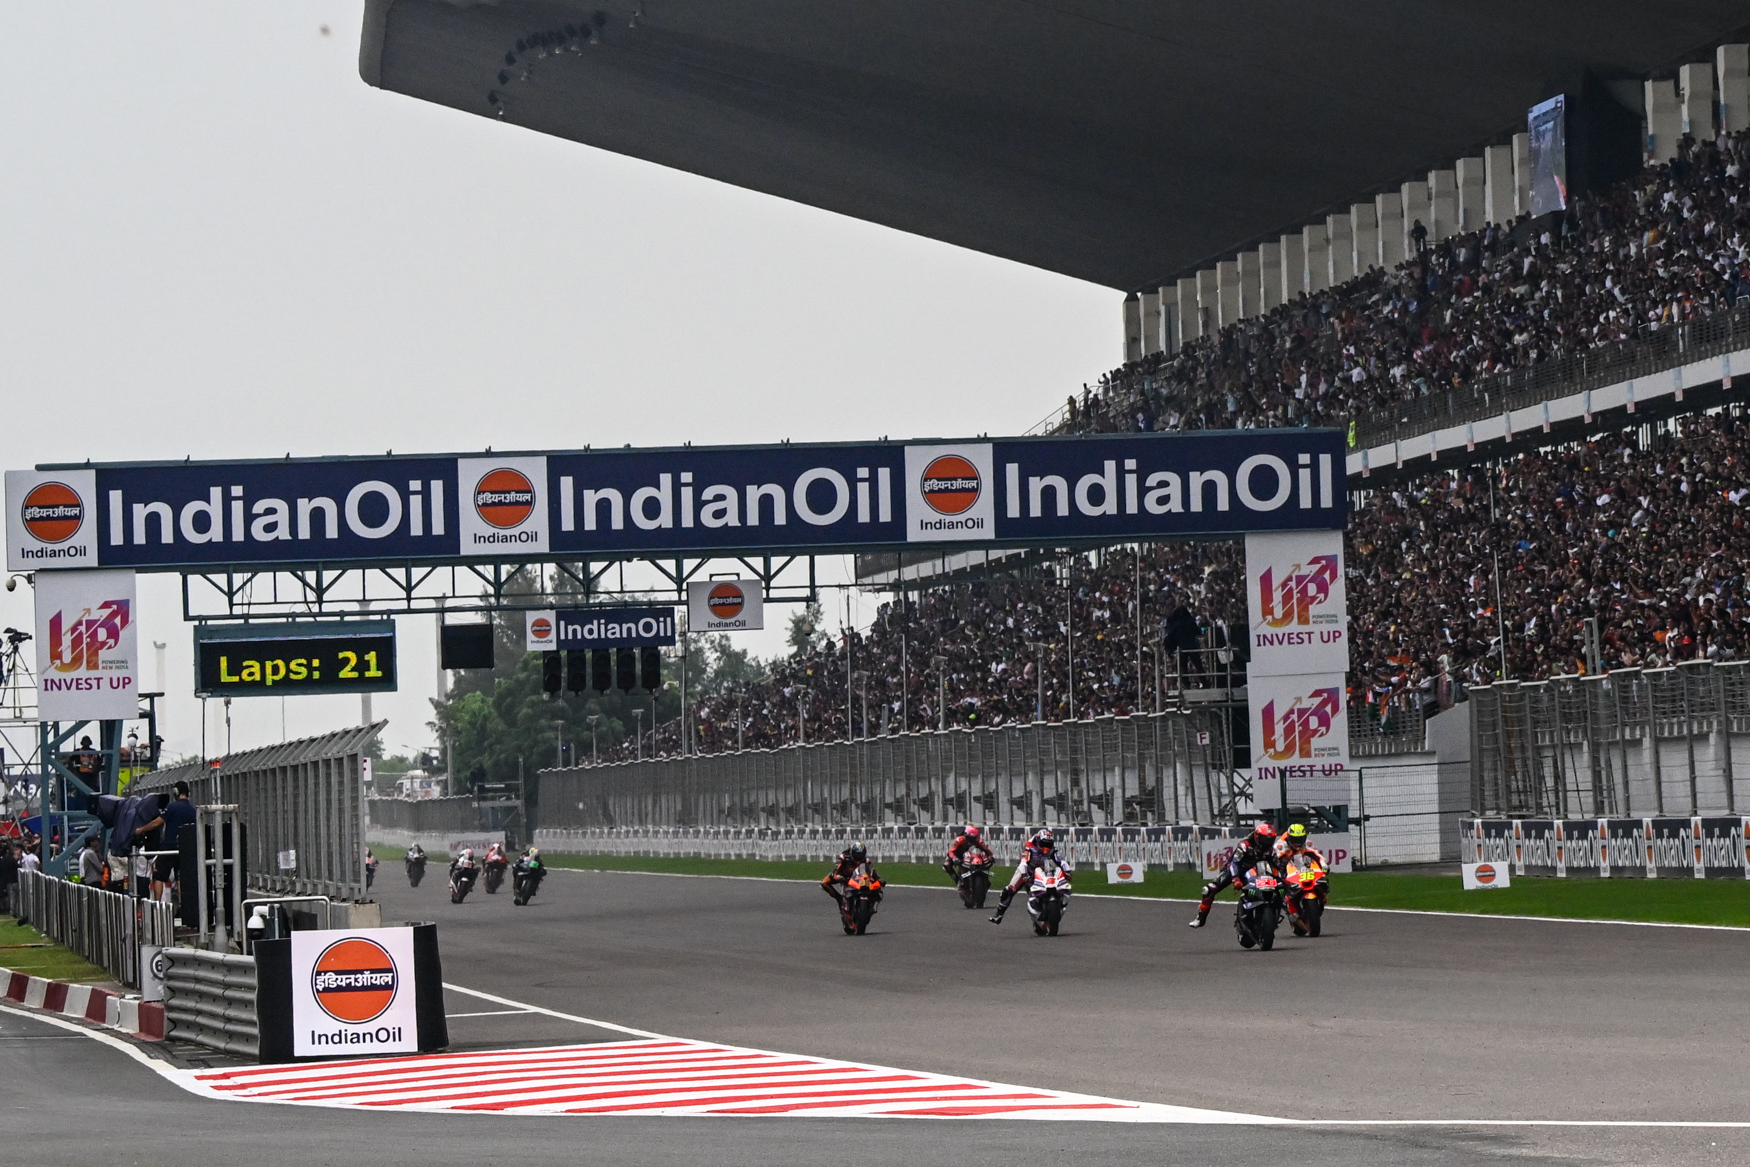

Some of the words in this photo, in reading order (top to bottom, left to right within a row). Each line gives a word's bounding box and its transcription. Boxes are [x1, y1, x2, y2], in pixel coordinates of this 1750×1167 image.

[923, 478, 978, 493] इंडियनऑयल
[1005, 452, 1333, 519] IndianOil
[477, 491, 532, 506] इंडियनऑयल
[560, 466, 892, 532] IndianOil
[25, 505, 80, 521] इंडियनऑयल
[109, 479, 444, 547] IndianOil
[920, 517, 984, 531] IndianOil
[473, 530, 539, 545] IndianOil
[21, 545, 87, 559] IndianOil
[559, 617, 672, 640] IndianOil
[707, 619, 747, 629] IndianOil
[1256, 631, 1315, 647] INVEST
[1320, 630, 1342, 644] UP
[220, 655, 320, 685] Laps:
[338, 650, 383, 679] 21
[43, 677, 103, 691] INVEST
[109, 676, 132, 689] UP
[1200, 732, 1207, 744] F
[1258, 764, 1316, 780] INVEST
[1321, 763, 1344, 777] UP
[1563, 828, 1600, 868] IndianOil
[1608, 827, 1645, 868] IndianOil
[1653, 827, 1694, 869] IndianOil
[1702, 827, 1745, 870] IndianOil
[1299, 872, 1315, 881] 36
[315, 971, 394, 992] इंडियनऑयल
[311, 1026, 402, 1045] IndianOil
